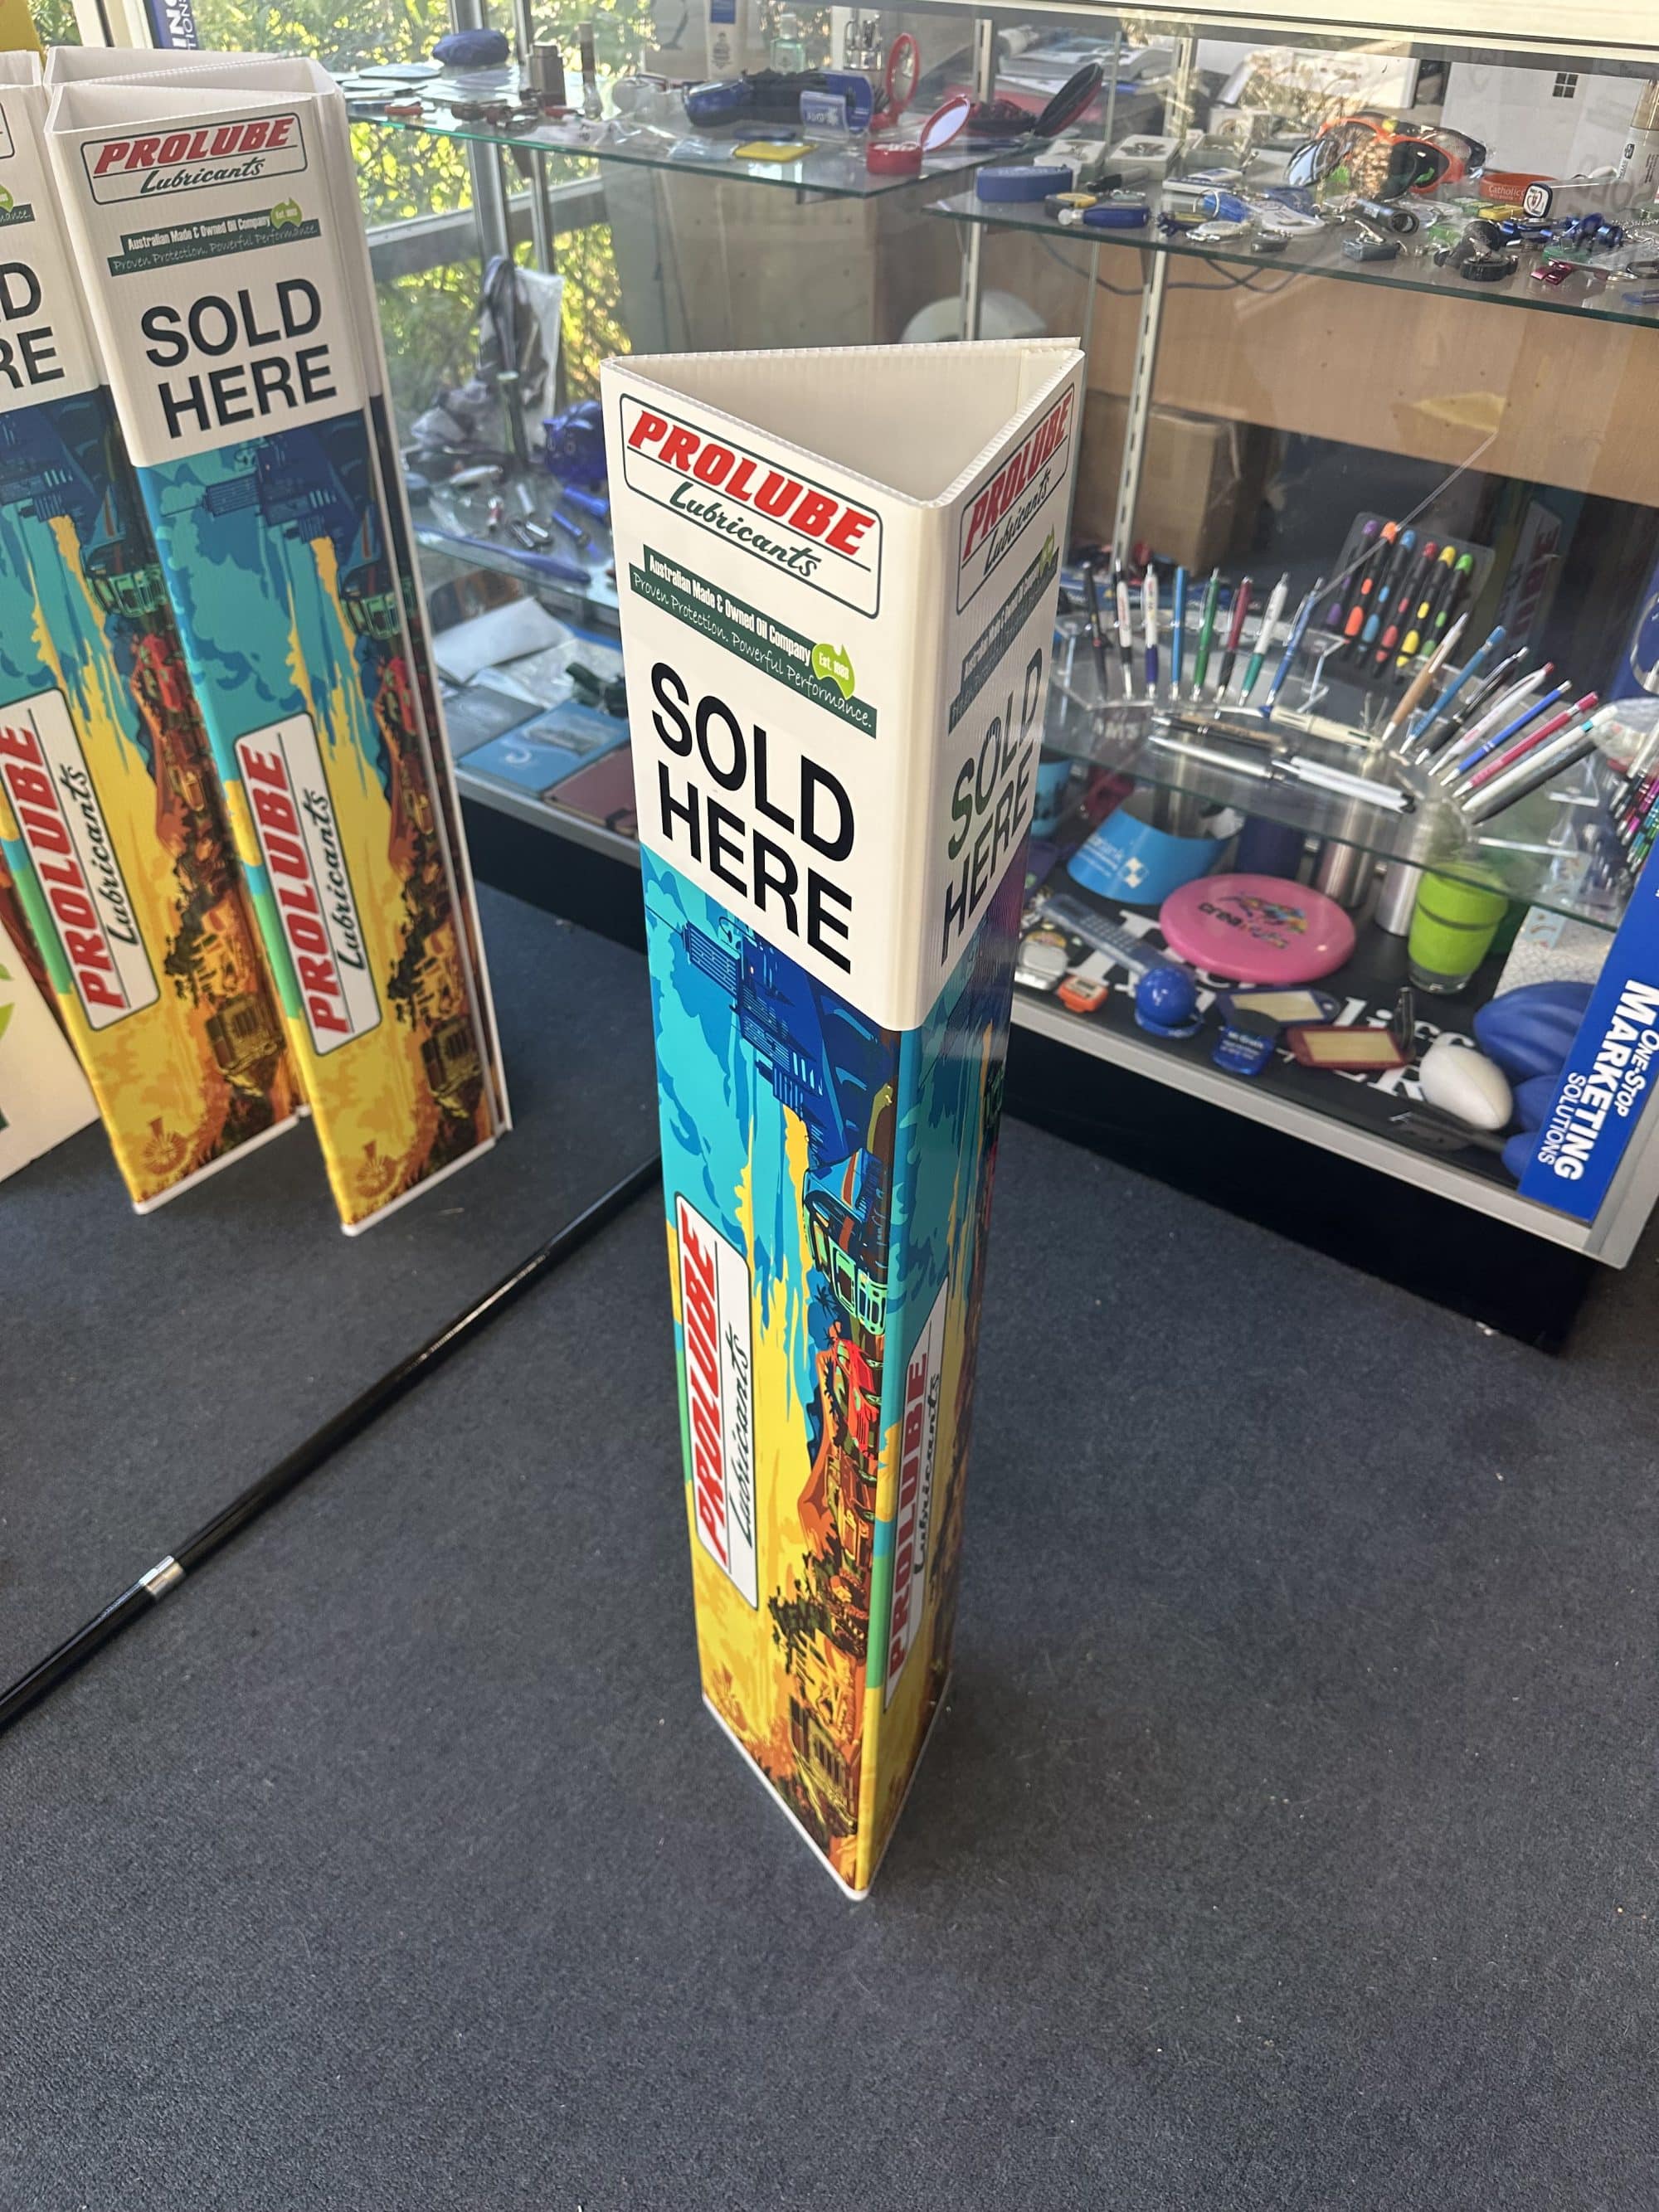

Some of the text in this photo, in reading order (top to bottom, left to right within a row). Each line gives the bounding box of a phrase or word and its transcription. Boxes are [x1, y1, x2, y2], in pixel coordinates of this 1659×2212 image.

[94, 118, 294, 174] PROLUBE
[140, 157, 265, 194] Lubricants
[113, 258, 151, 271] Proven
[128, 233, 170, 250] Australian
[170, 229, 192, 245] Made
[201, 221, 227, 237] Owned
[141, 278, 321, 367] SOLD
[158, 344, 337, 439] HERE
[963, 391, 1073, 562] PROLUBE
[628, 410, 876, 556] PROLUBE
[669, 481, 822, 577] Lubricants
[984, 468, 1051, 576] Lubricants
[634, 572, 872, 727] Proven Protection. Powerful Performance.
[649, 555, 811, 667] Australian Made & Owned Oil Company
[651, 662, 854, 862] SOLD
[948, 648, 1043, 860] SOLD
[0, 725, 124, 1009] PROLUBE
[60, 764, 139, 946] Lubricants
[240, 744, 349, 1034] PROLUBE
[302, 787, 366, 970] Lubricants
[658, 761, 853, 975] HERE
[941, 741, 1034, 967] HERE
[1537, 1072, 1587, 1165] SOLUTIONS
[1554, 980, 1659, 1181] MARKETING
[680, 1202, 727, 1567] PROLUBE
[726, 1321, 753, 1548] Lubricants
[889, 1352, 927, 1680] PROLUBE
[913, 1373, 940, 1574] Lubricants
